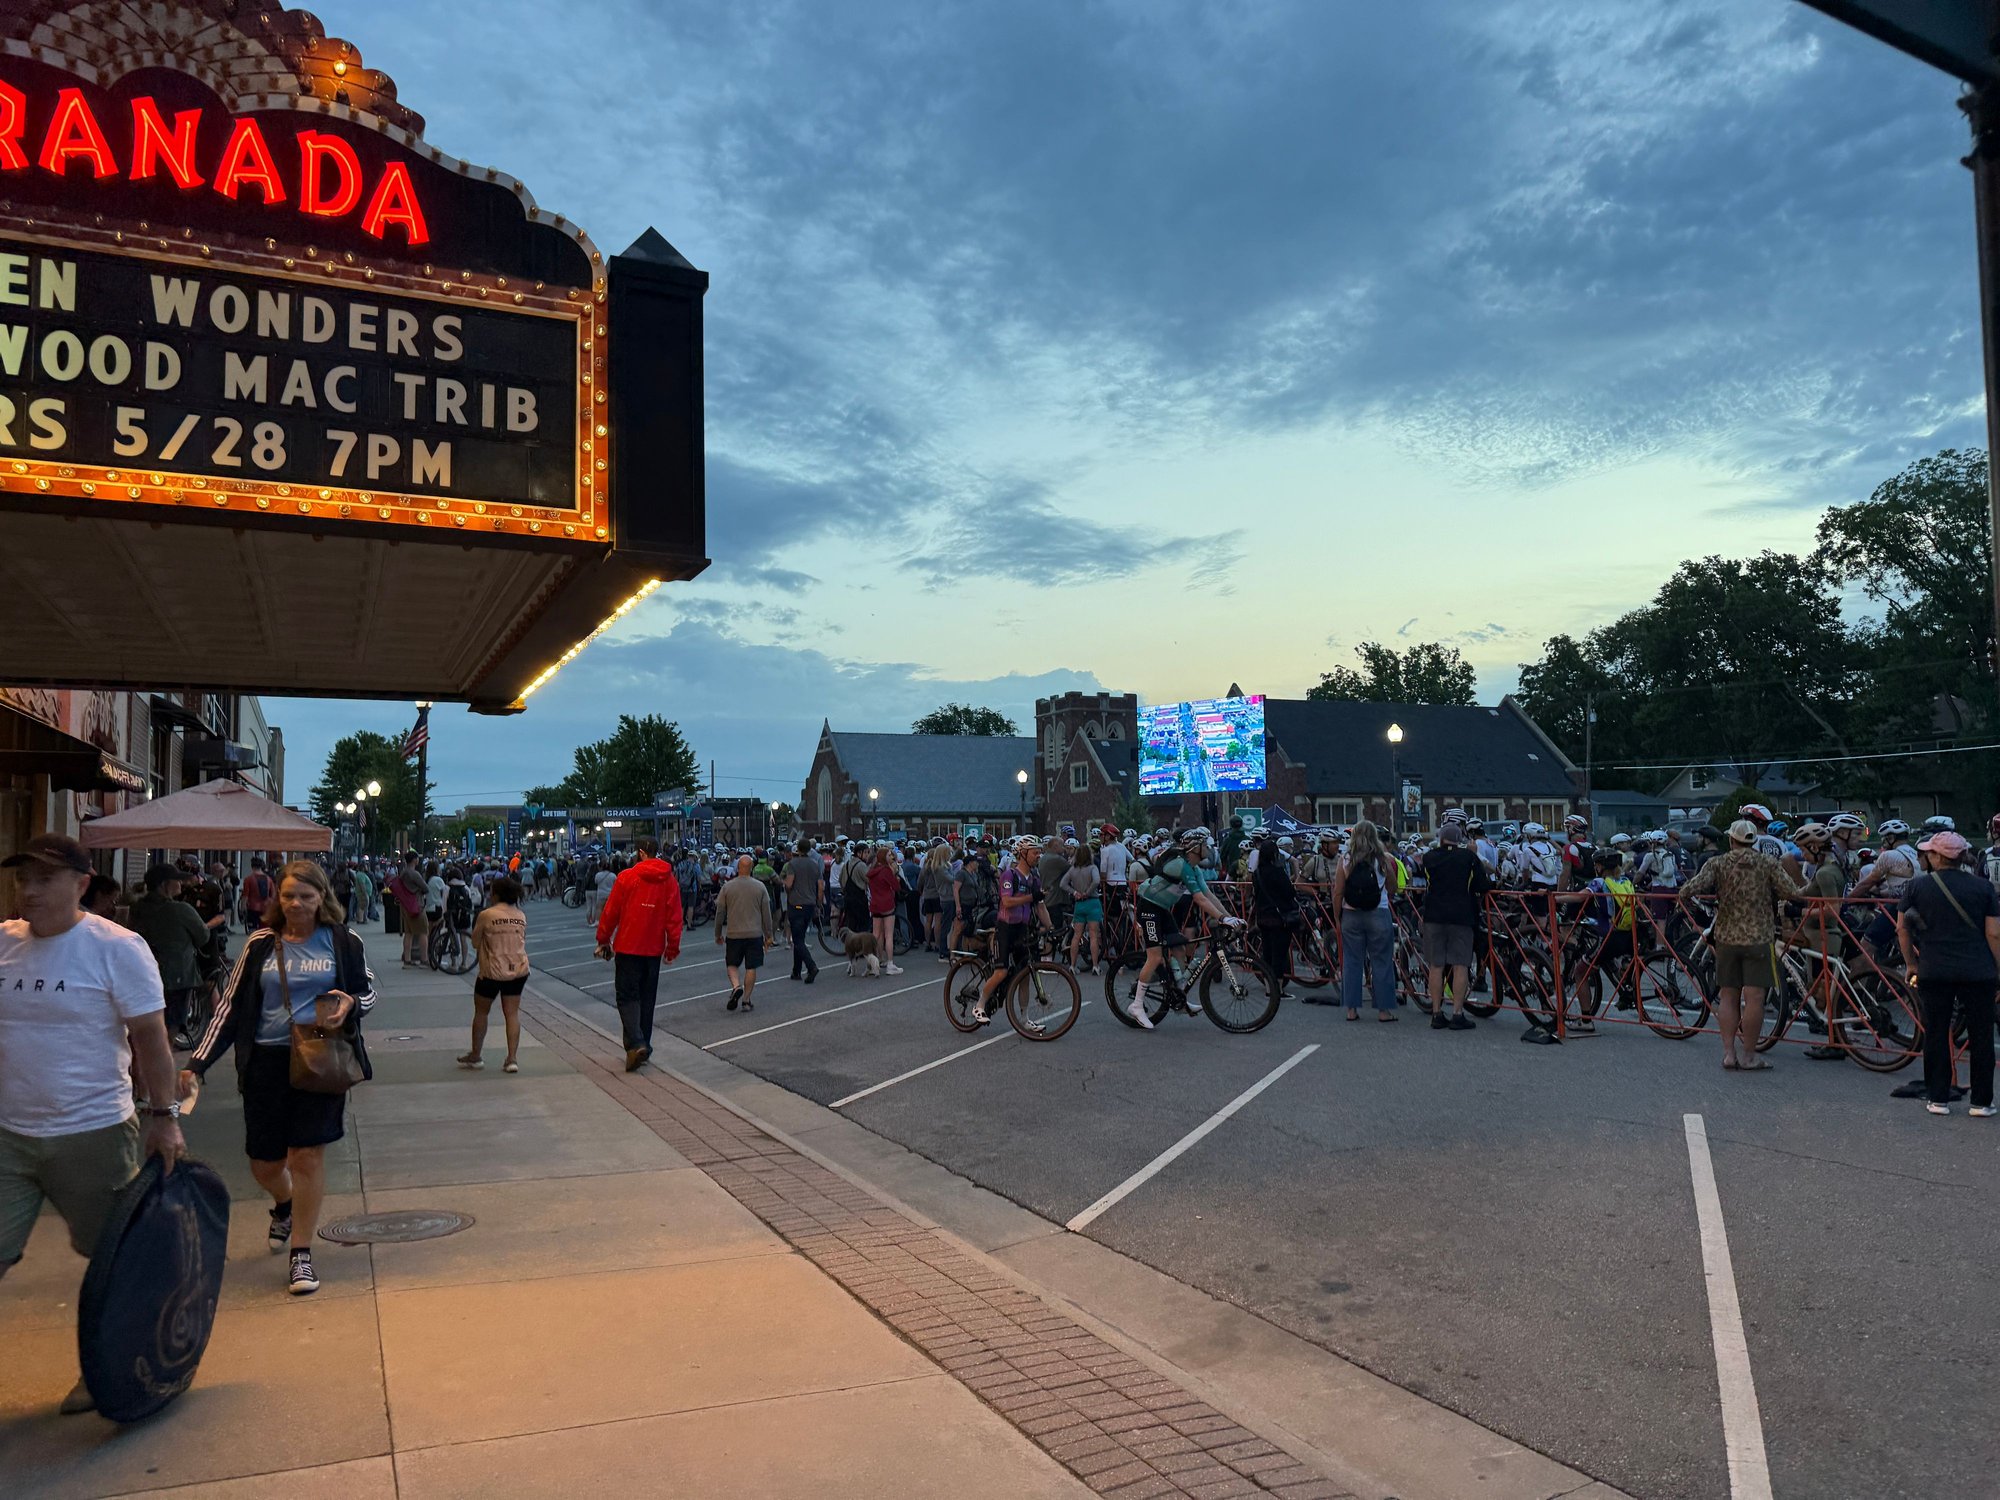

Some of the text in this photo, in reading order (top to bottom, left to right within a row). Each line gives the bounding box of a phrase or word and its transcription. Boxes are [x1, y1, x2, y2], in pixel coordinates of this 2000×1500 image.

[0, 252, 464, 362] EN WONDERS
[223, 351, 358, 413] MAC
[394, 372, 540, 433] TRIB
[113, 406, 287, 471] 5/28
[326, 428, 452, 488] 7PM
